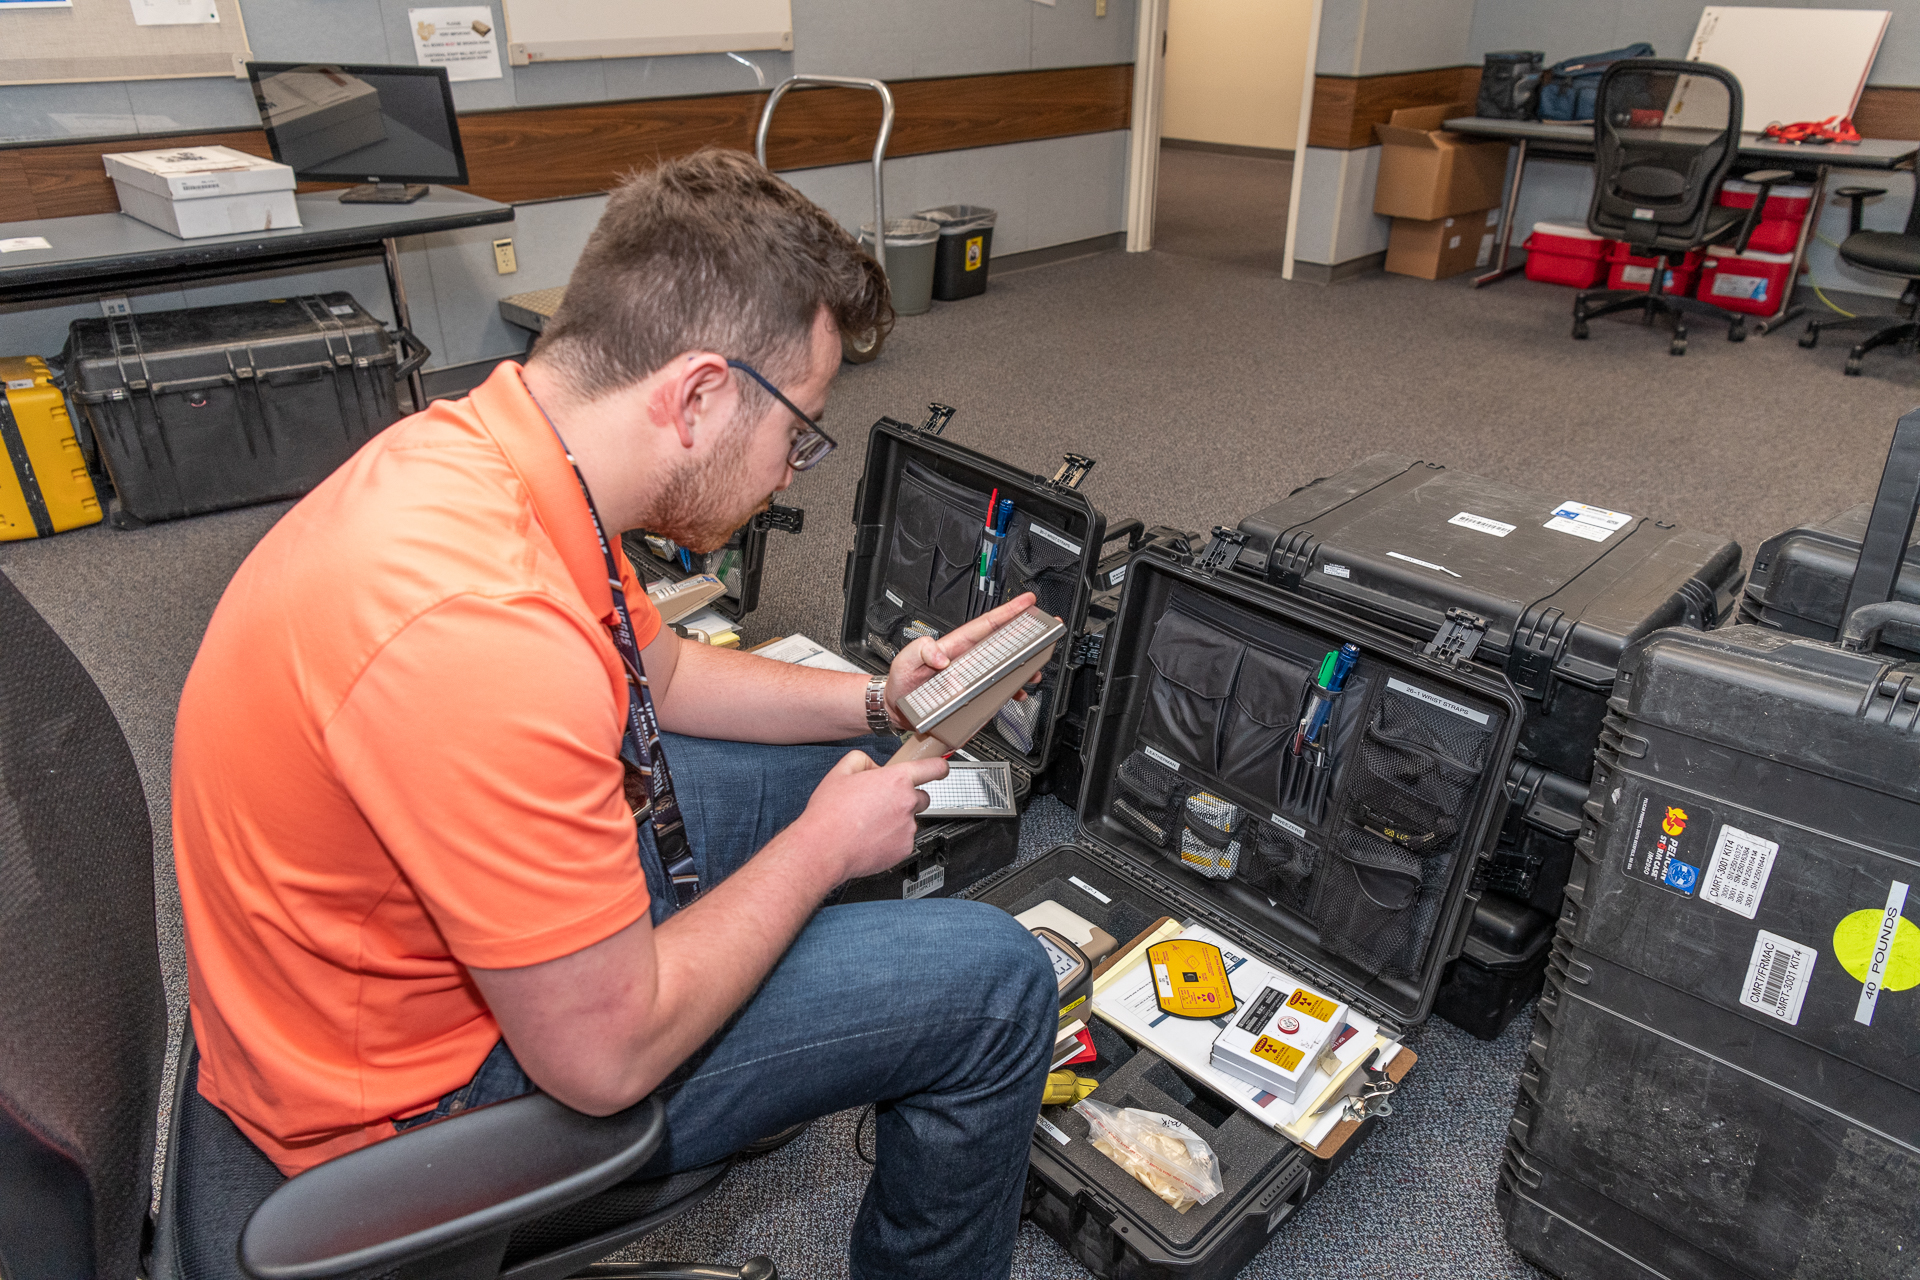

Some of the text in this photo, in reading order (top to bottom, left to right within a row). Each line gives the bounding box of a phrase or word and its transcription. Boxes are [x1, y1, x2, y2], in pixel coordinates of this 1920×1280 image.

[1406, 687, 1469, 715] 26-1 WRIST STRAPS
[629, 703, 639, 726] GOLDEN
[1146, 748, 1176, 768] LEATHERMAN
[653, 760, 664, 796] VEGAS
[1274, 816, 1303, 835] TWEEZERS
[1650, 860, 1660, 878] CASE
[1711, 838, 1734, 896] CMRT-3001 KIT4
[1720, 884, 1730, 898] 3001
[1728, 886, 1736, 900] 3001
[1735, 890, 1744, 904] 3001
[1744, 893, 1753, 907] 3001
[1865, 906, 1898, 1000] 40 POUNDS
[1750, 942, 1776, 1004] CMRT/FRMAC
[1776, 950, 1802, 1017] CMRT-3001 KIT4
